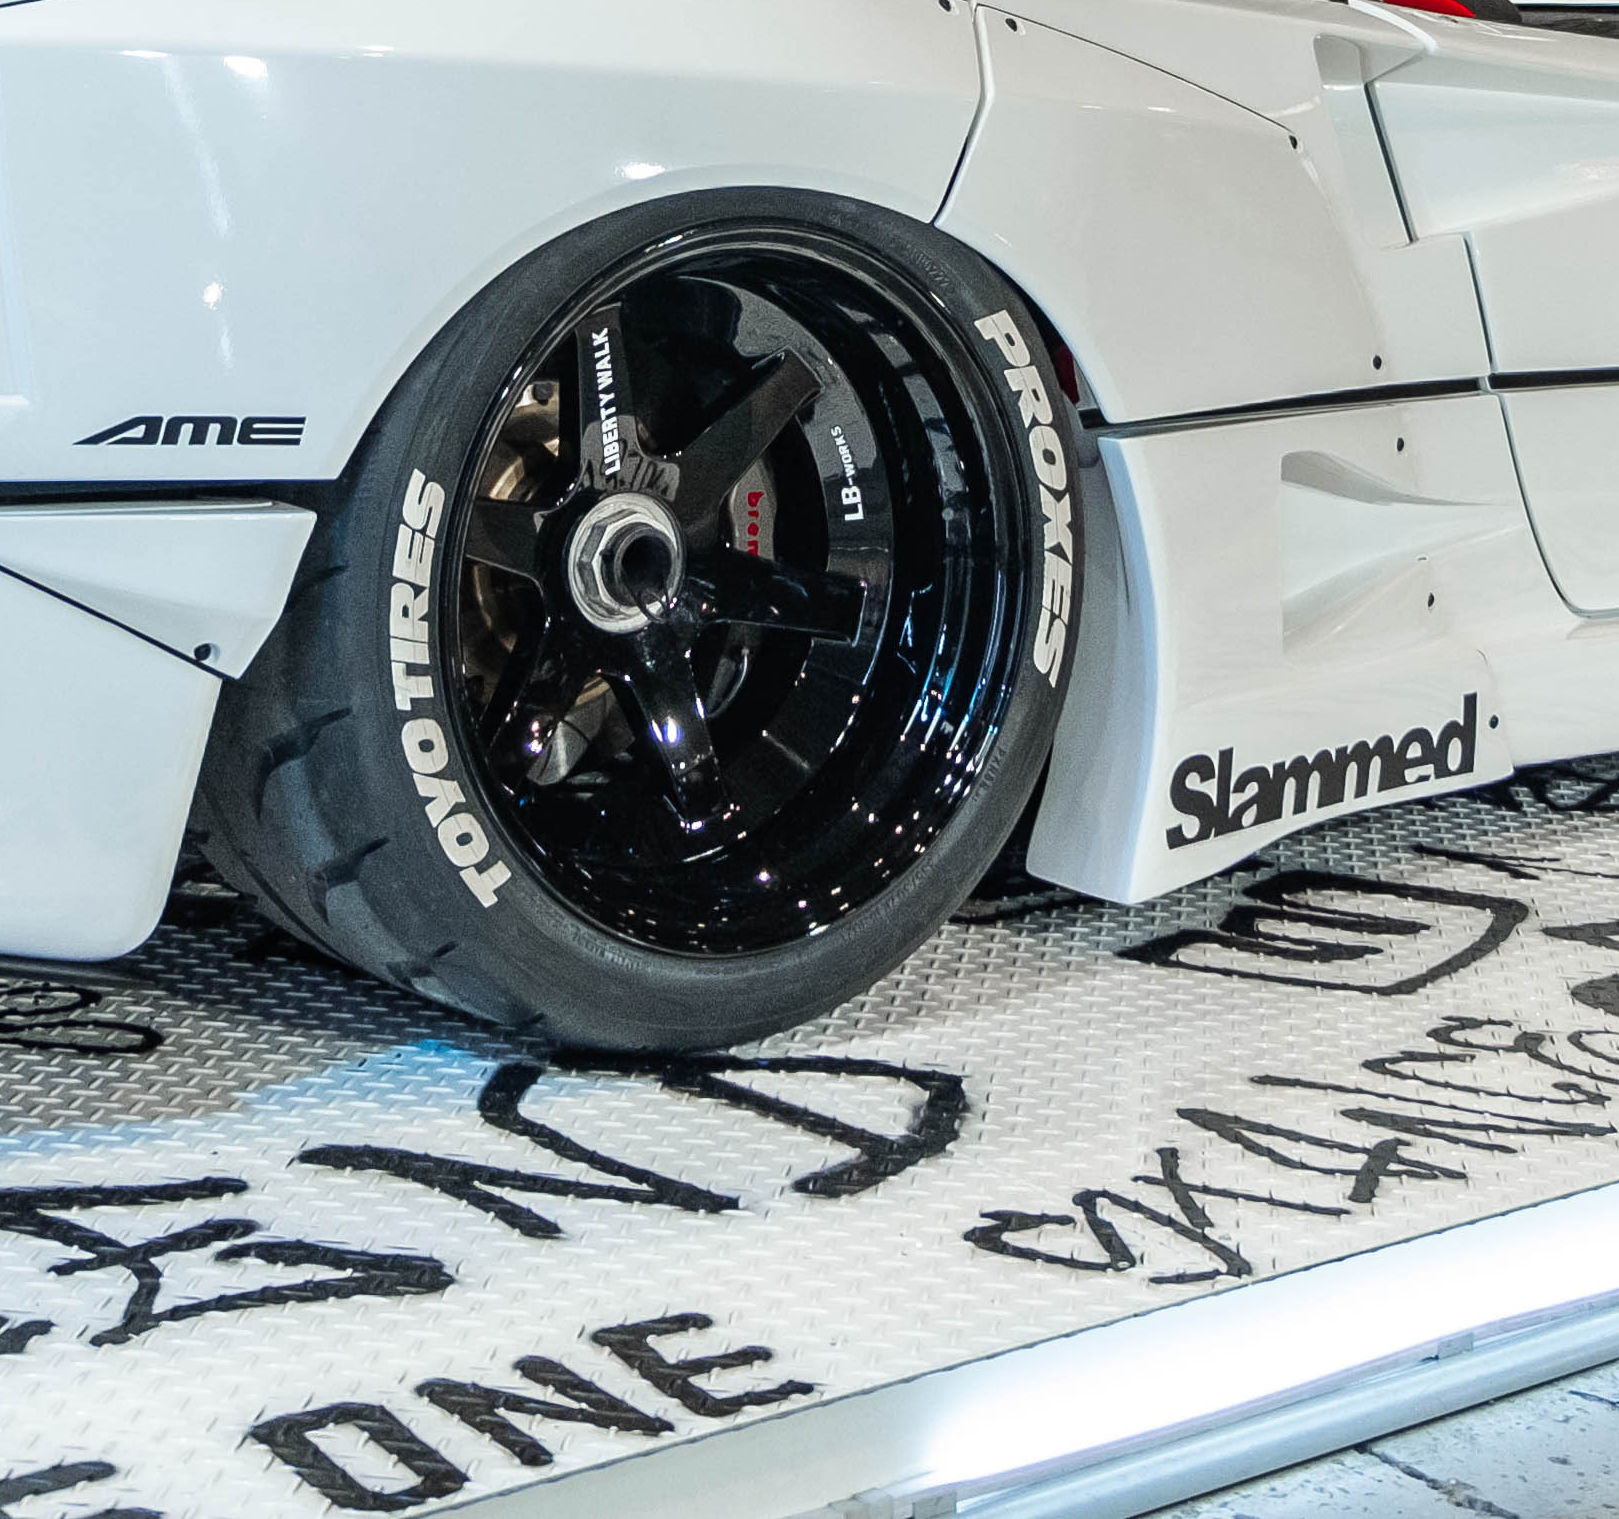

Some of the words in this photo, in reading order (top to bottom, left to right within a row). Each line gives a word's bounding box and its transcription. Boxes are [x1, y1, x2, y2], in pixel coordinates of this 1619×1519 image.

[591, 327, 614, 387] WALK
[596, 389, 622, 476] LIBERTY
[830, 425, 865, 522] LB-WORKS
[974, 308, 1073, 689] PROXES
[389, 468, 447, 710] TIRES
[399, 715, 513, 909] TOYO
[1165, 691, 1478, 850] Slammed
